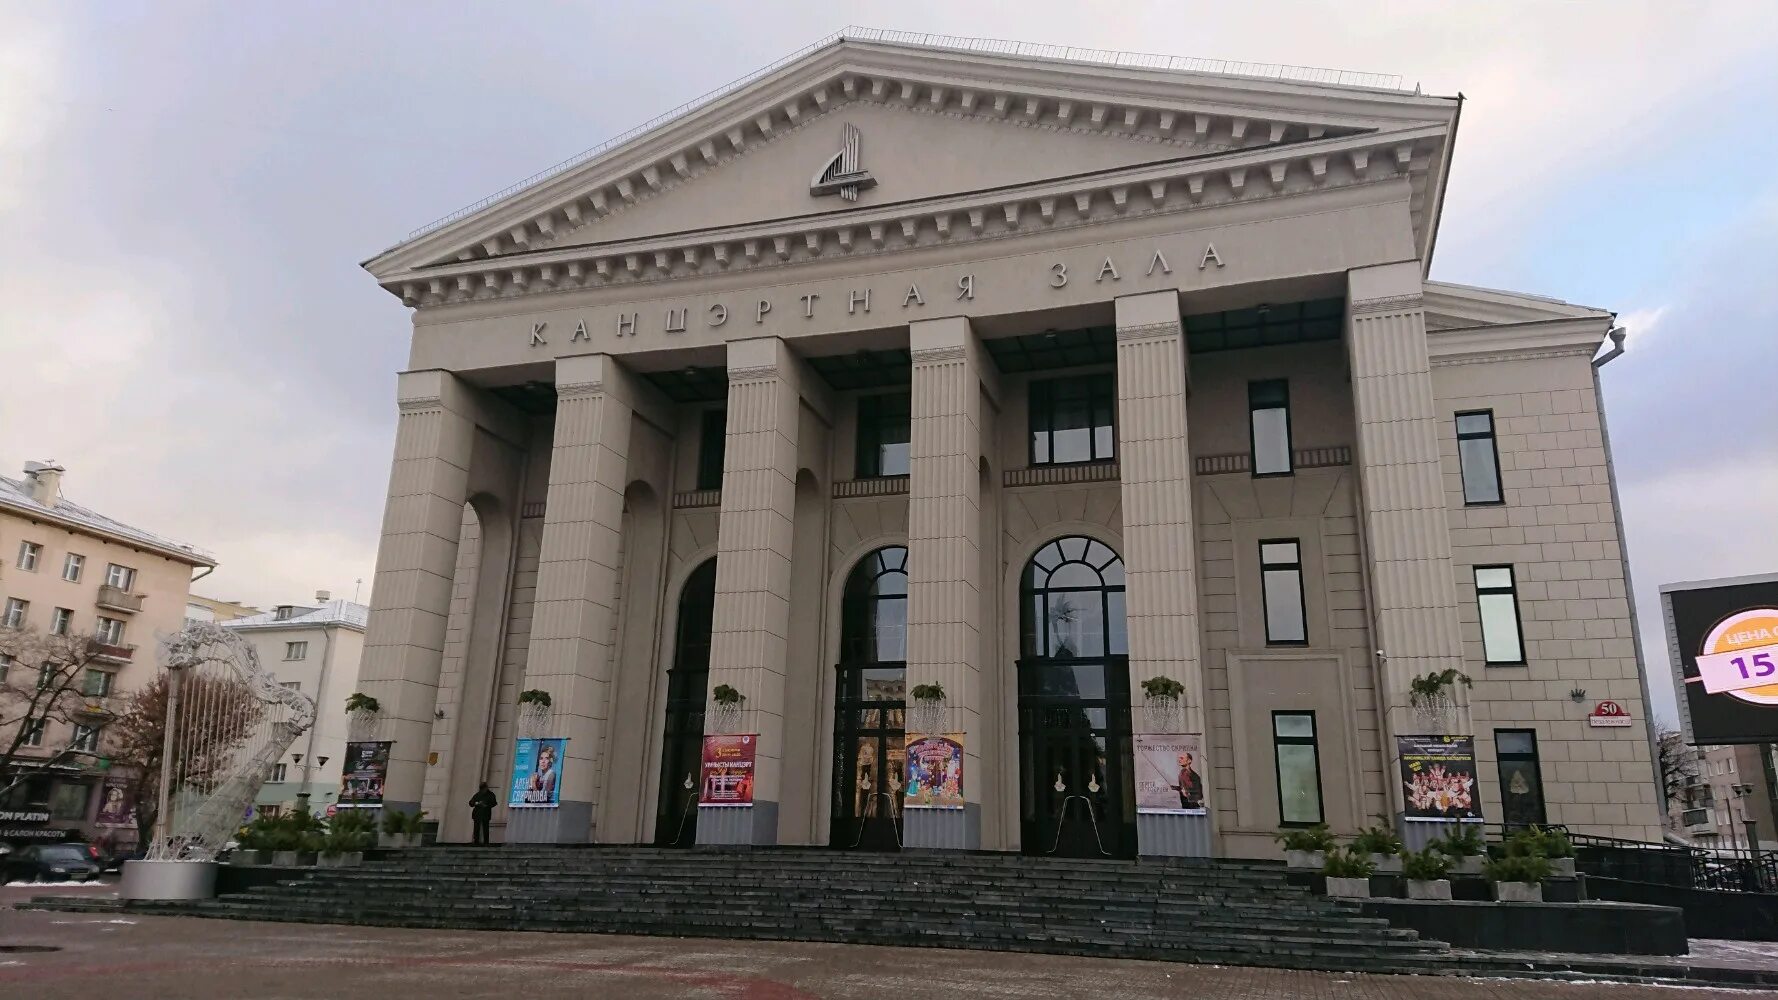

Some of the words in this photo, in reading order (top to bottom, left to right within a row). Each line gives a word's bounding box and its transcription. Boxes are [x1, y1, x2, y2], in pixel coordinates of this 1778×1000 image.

[529, 273, 975, 347] КАНЦЭРТНАЯ
[1050, 241, 1226, 288] ЗАЛА
[1726, 628, 1773, 646] ЦЕНА
[1730, 652, 1776, 680] 15
[1601, 703, 1617, 715] 50
[14, 812, 49, 822] PLATIN
